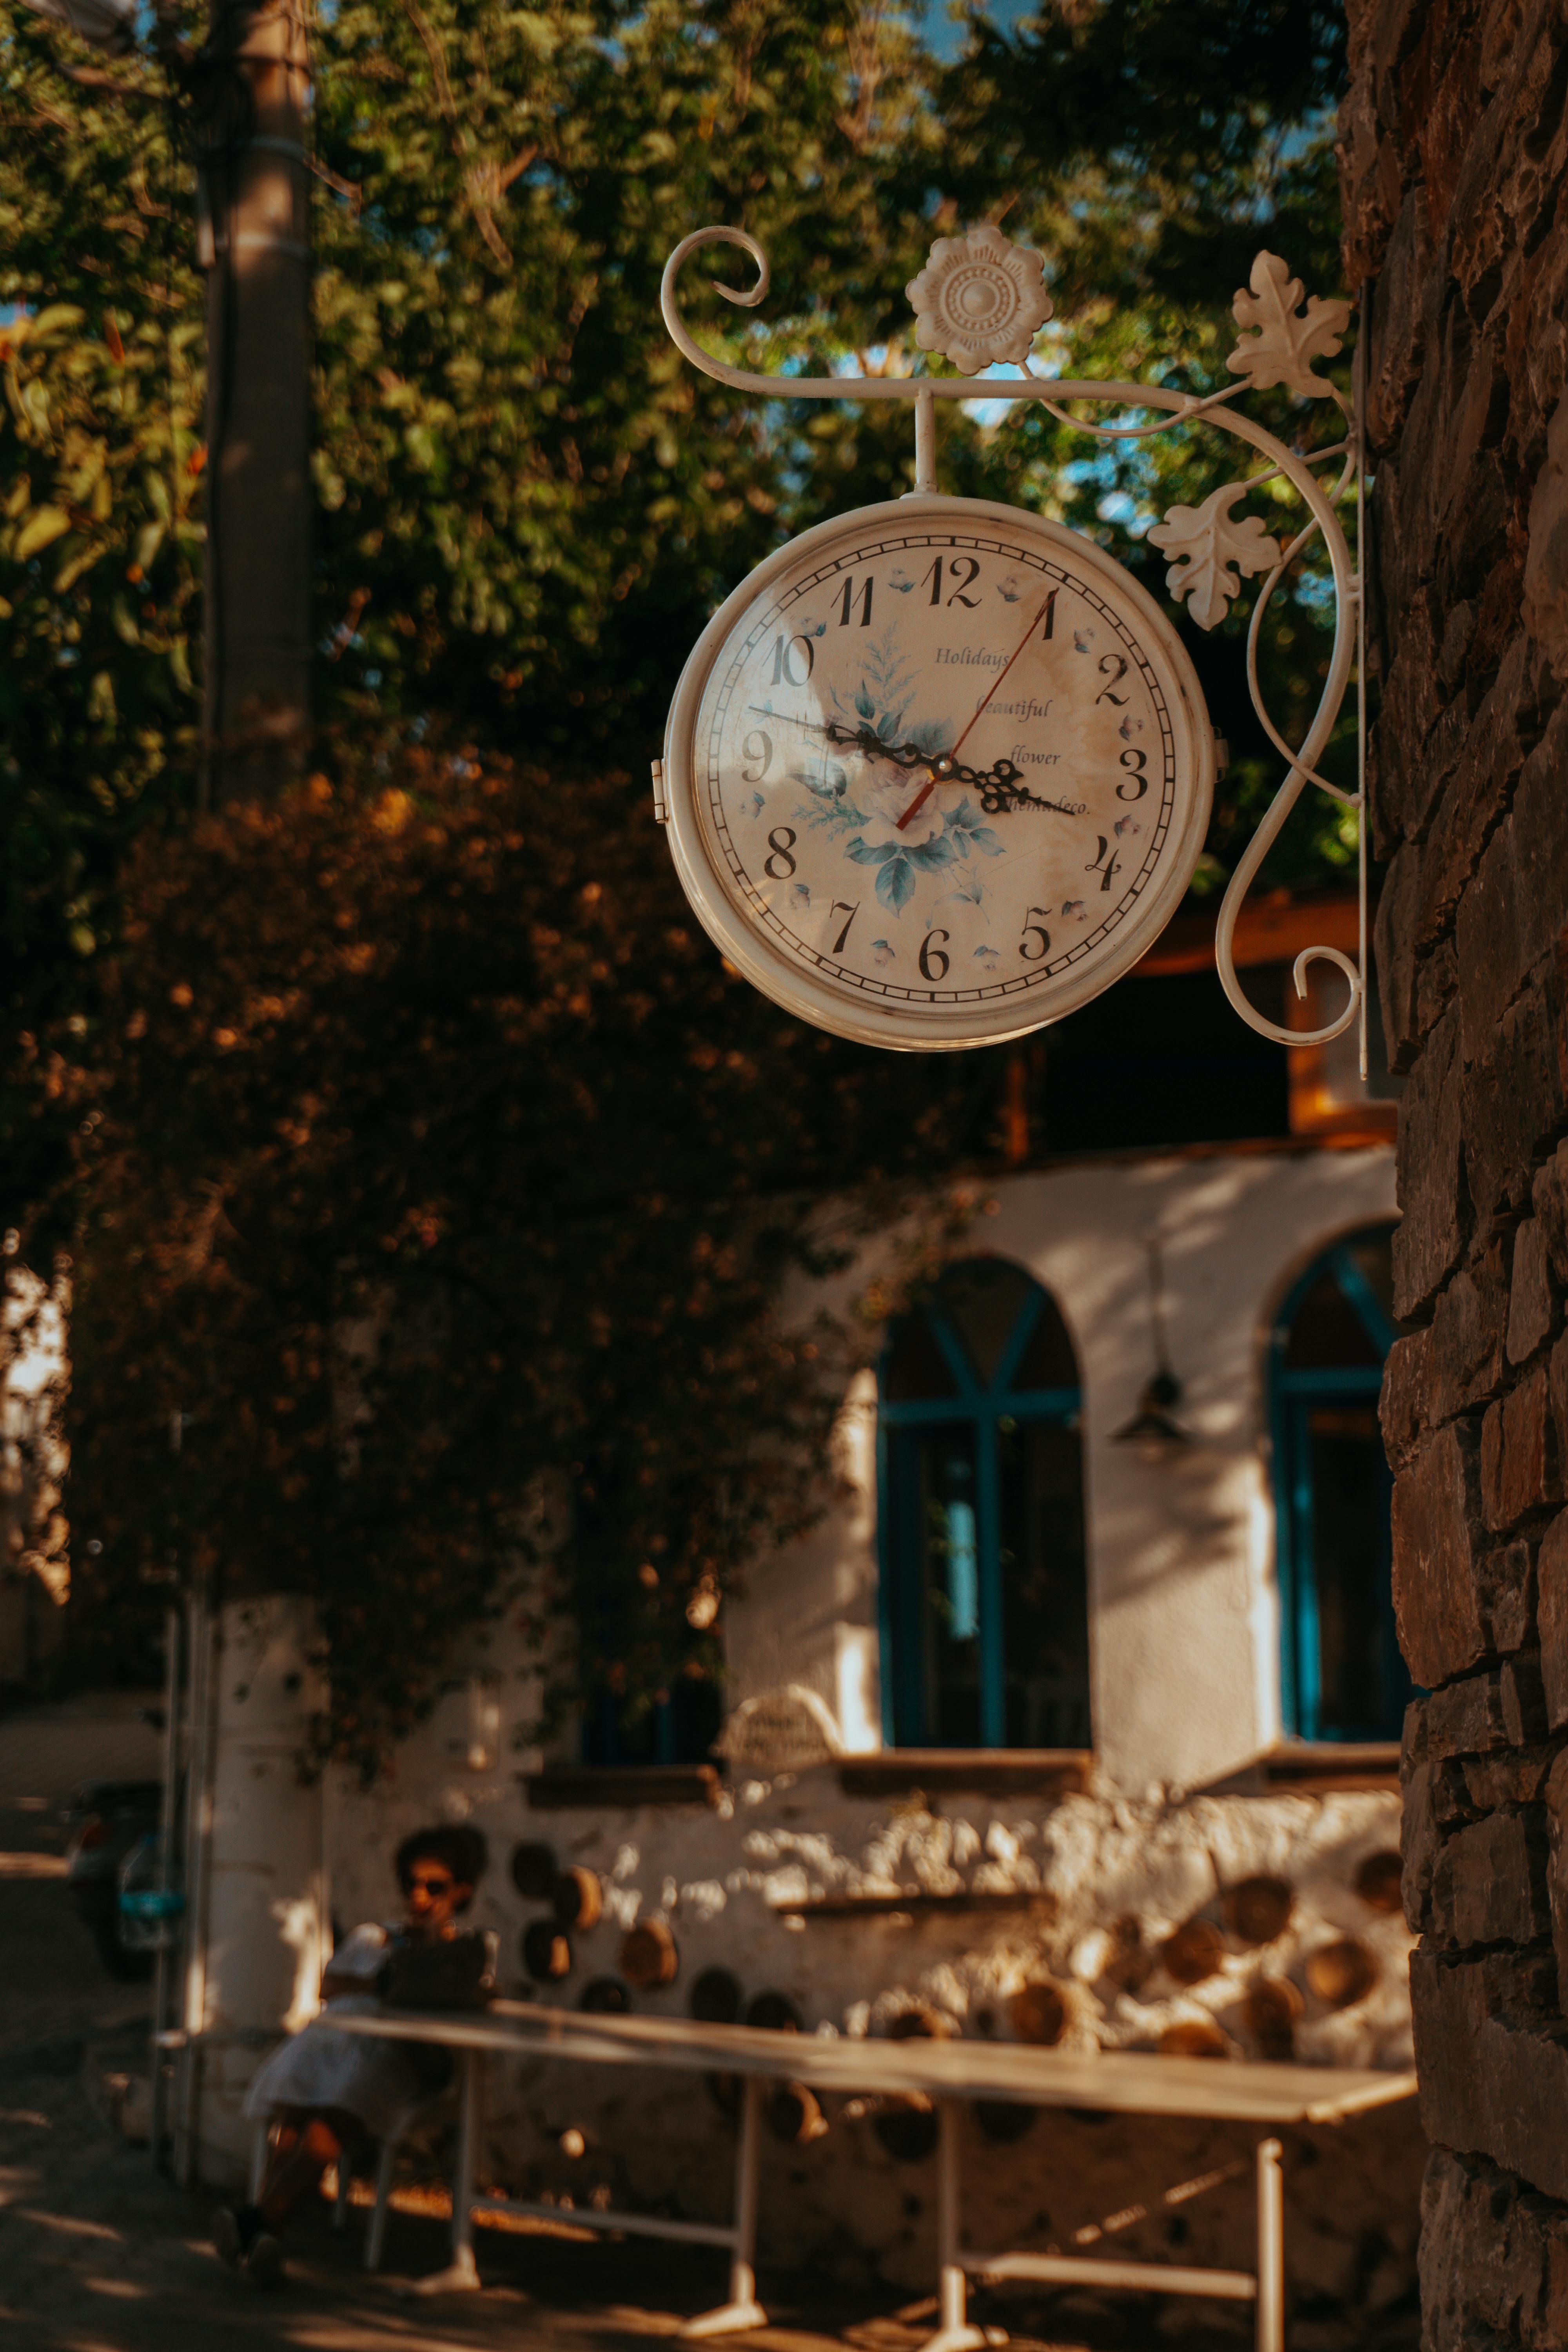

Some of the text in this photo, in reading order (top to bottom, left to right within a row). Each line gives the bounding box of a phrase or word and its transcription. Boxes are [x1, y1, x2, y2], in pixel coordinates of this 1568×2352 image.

[831, 576, 873, 626] 11
[921, 556, 982, 608] 12
[1034, 590, 1056, 640] 1
[762, 635, 814, 687] 10
[935, 647, 1010, 673] Holidays
[1096, 654, 1130, 706] 2
[742, 730, 773, 782] 9
[1001, 745, 1061, 769] flower
[1116, 749, 1147, 801] 3
[764, 827, 796, 879] 8
[1085, 836, 1122, 891] 4
[830, 900, 860, 954] 7
[1019, 907, 1052, 960] 5
[919, 929, 949, 981] 6
